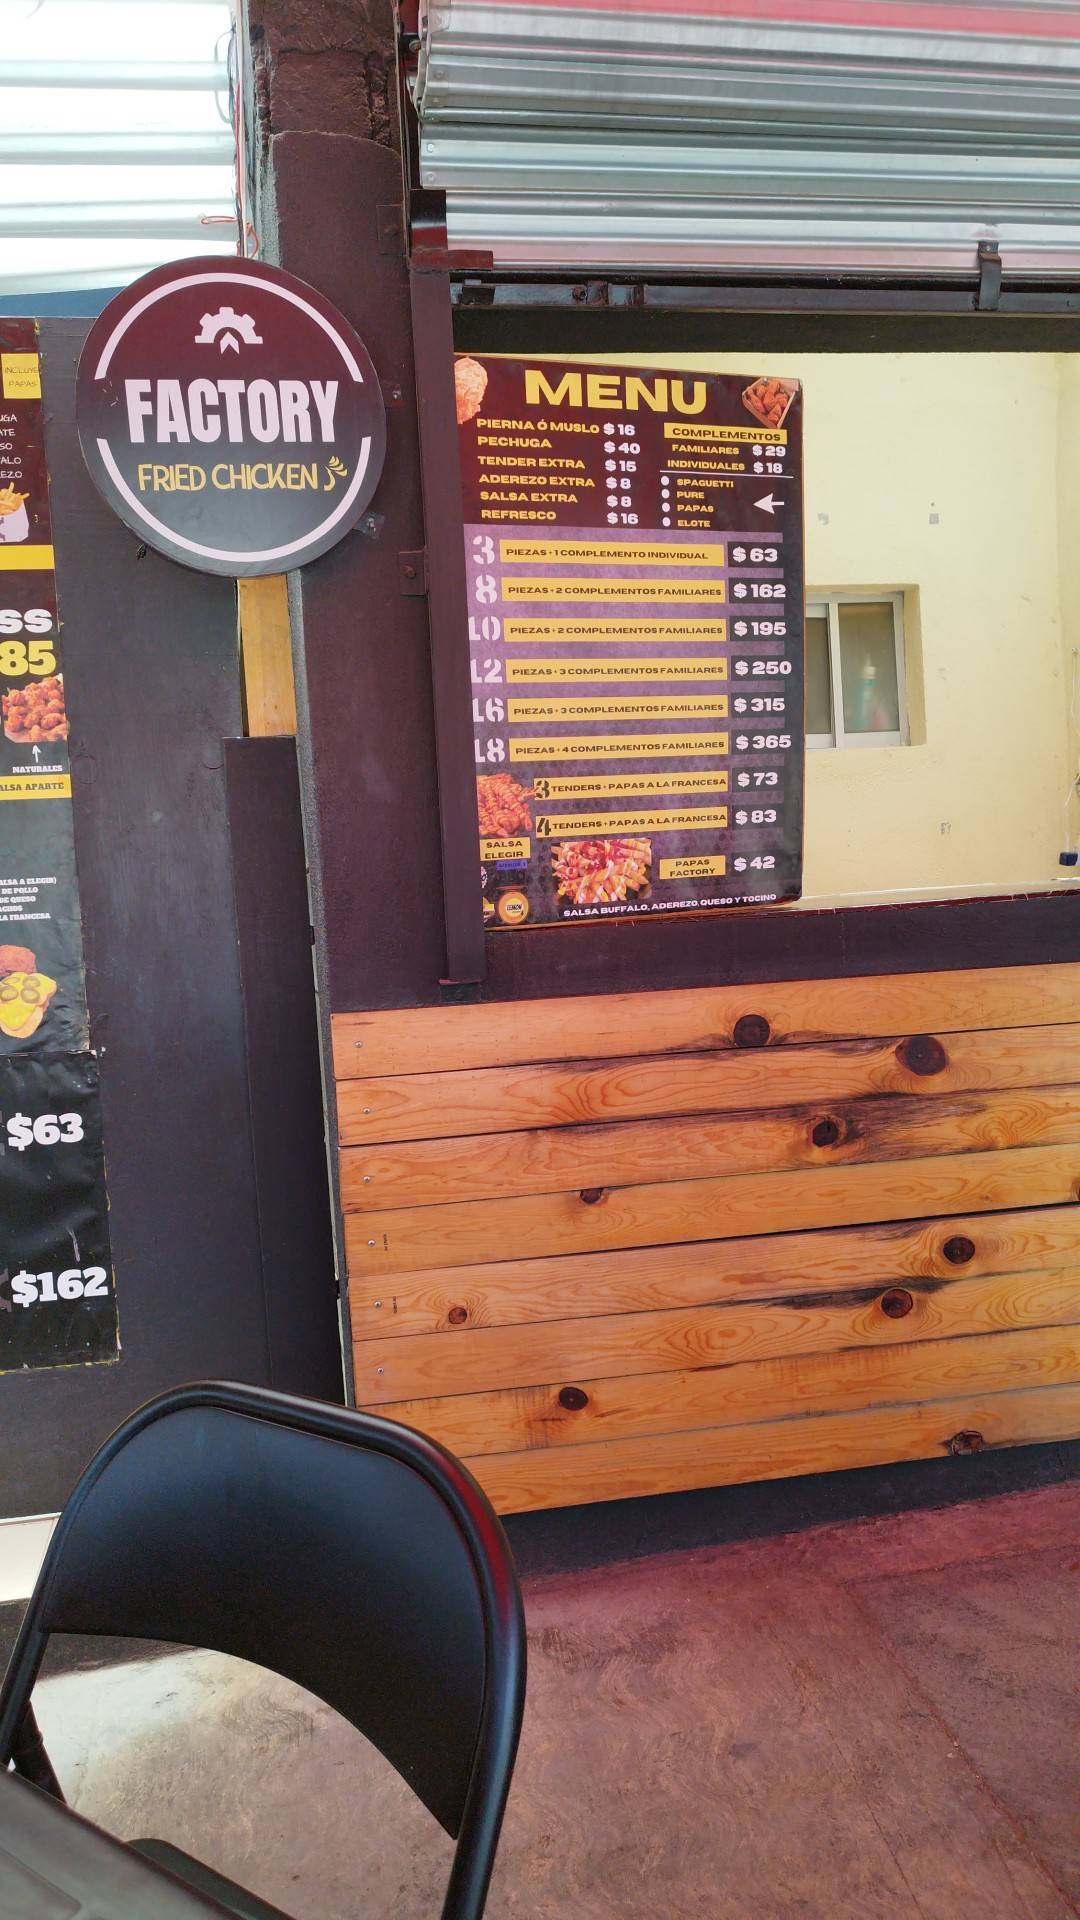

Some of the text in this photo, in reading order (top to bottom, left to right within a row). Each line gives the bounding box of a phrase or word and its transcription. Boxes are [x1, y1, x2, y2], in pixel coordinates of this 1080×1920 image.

[525, 369, 707, 415] MENU
[124, 379, 338, 443] FACTORY
[476, 419, 600, 434] PIERNA Ó MUSLO
[672, 428, 781, 441] COMPLEMENTOS
[477, 436, 552, 448] PECHUGA
[672, 444, 740, 455] FAMILIARES
[0, 456, 21, 464] ALO
[478, 456, 586, 469] TENDER EXTRA
[667, 460, 745, 470] INDIVIDUALES
[0, 471, 22, 479] EZO
[138, 463, 319, 492] FRIED CHICKEN
[479, 474, 595, 487] ADEREZO EXTRA
[676, 479, 734, 488] SPAGUETTI
[480, 491, 578, 503] SALSA EXTRA
[676, 491, 705, 499] PURE
[481, 509, 557, 520] REFRESCO
[677, 504, 714, 513] PAPAS
[677, 520, 710, 528] ELOTE
[473, 535, 495, 565] 3
[560, 550, 646, 558] COMPLEMENTO
[475, 574, 497, 604] 8
[564, 587, 656, 595] COMPLEMENTOS
[0, 609, 52, 633] SS
[512, 668, 552, 676] PIEZAS
[568, 667, 659, 675] COMPLEMENTOS
[514, 707, 553, 715] PIEZAS
[569, 705, 659, 713] COMPLEMENTOS
[661, 704, 723, 712] FAMILIARES
[516, 746, 555, 754] PIEZAS
[570, 743, 660, 752] COMPLEMENTOS
[662, 741, 724, 750] FAMILIARES
[12, 765, 62, 773] NATURALES
[534, 780, 550, 798] 3
[552, 784, 601, 793] TENDERS
[609, 781, 645, 789] PAPAS
[646, 780, 655, 788] A
[672, 777, 726, 787] FRANCESA
[536, 816, 551, 836] 4
[552, 820, 602, 830] TENDERS
[609, 818, 645, 827] PAPAS
[658, 816, 671, 824] LA
[672, 814, 726, 823] FRANCESA
[485, 840, 523, 848] SALSA
[484, 851, 524, 859] ELEGIR
[669, 868, 715, 877] FACTORY
[563, 908, 599, 917] SALSA
[700, 897, 732, 906] QUESO
[742, 893, 776, 902] TOCINO
[7, 1113, 84, 1151] $63
[11, 1267, 108, 1308] $162
